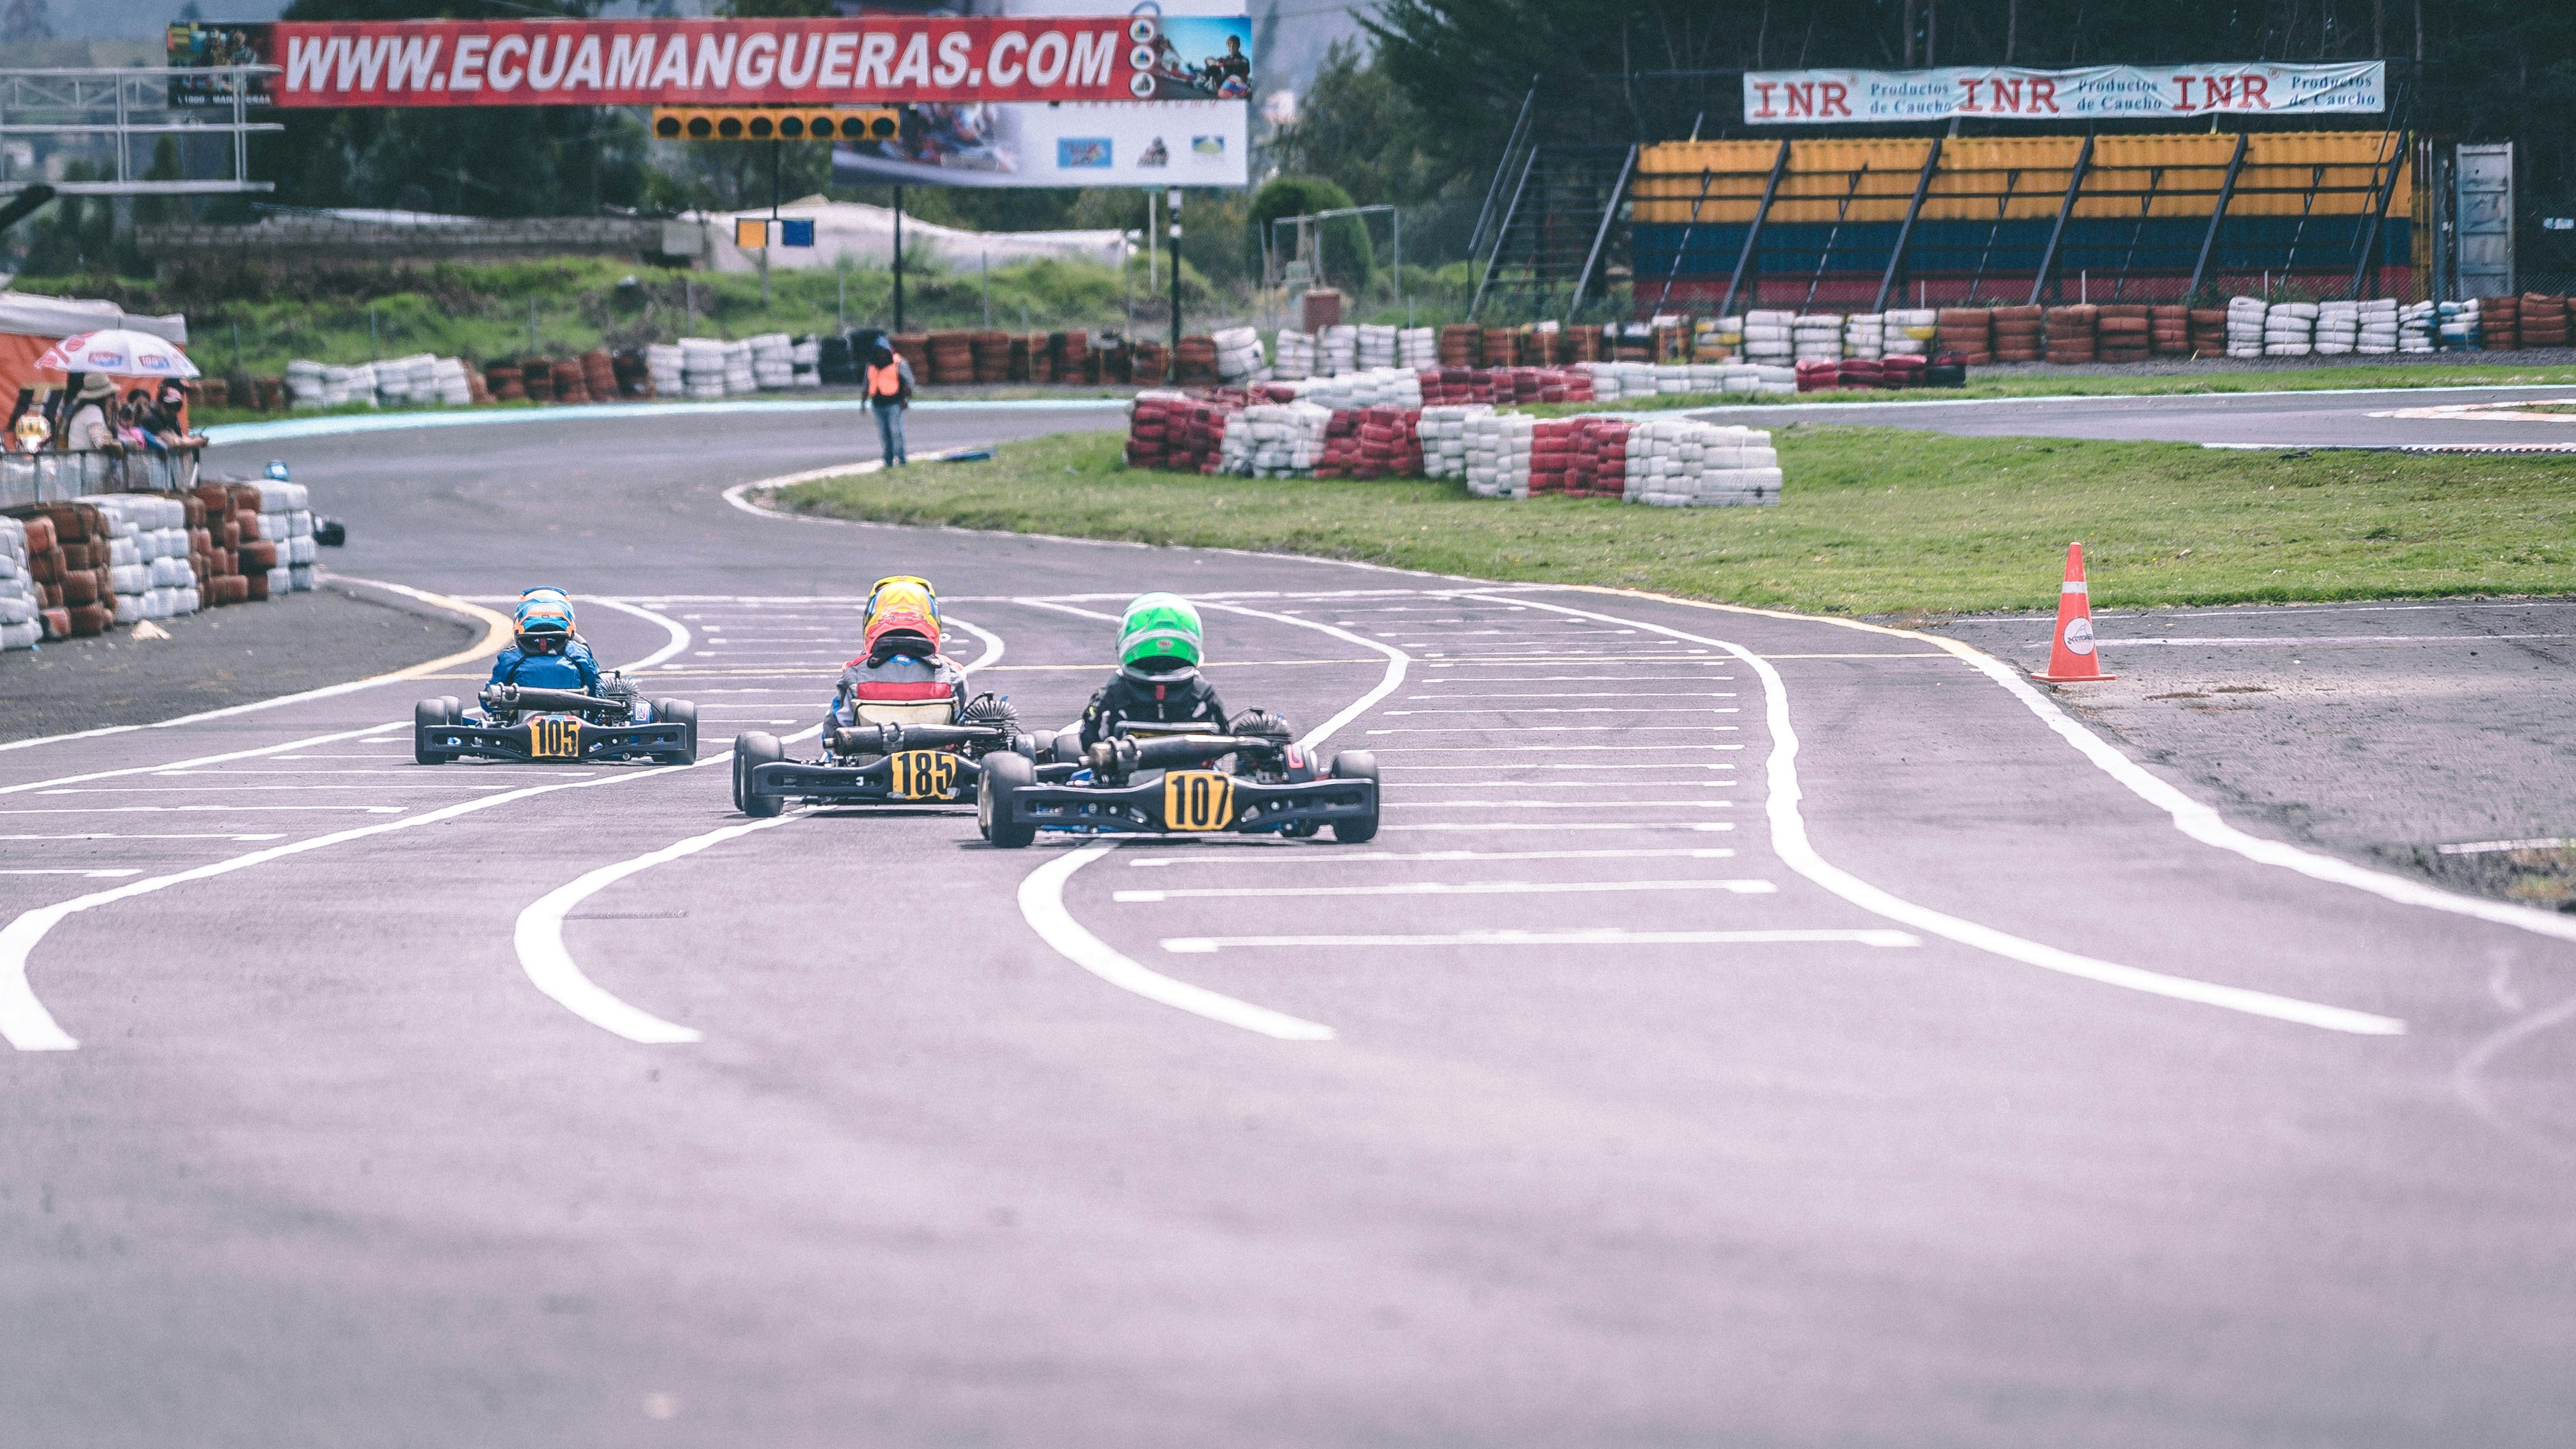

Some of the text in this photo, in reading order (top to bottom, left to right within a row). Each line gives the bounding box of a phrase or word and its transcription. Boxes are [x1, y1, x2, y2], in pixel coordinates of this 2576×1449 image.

[285, 31, 1119, 91] WWW.ECUAMANGUERAS.COM
[1871, 82, 1949, 96] Productos
[2079, 78, 2158, 92] Productos
[2291, 76, 2372, 89] Productos
[1959, 78, 2060, 113] INR
[2077, 95, 2161, 111] de Caucho
[2289, 91, 2375, 106] de Caucho
[1871, 98, 1952, 114] de Caucho
[535, 718, 577, 756] 105
[898, 753, 953, 796] 185
[1171, 775, 1229, 826] 107
